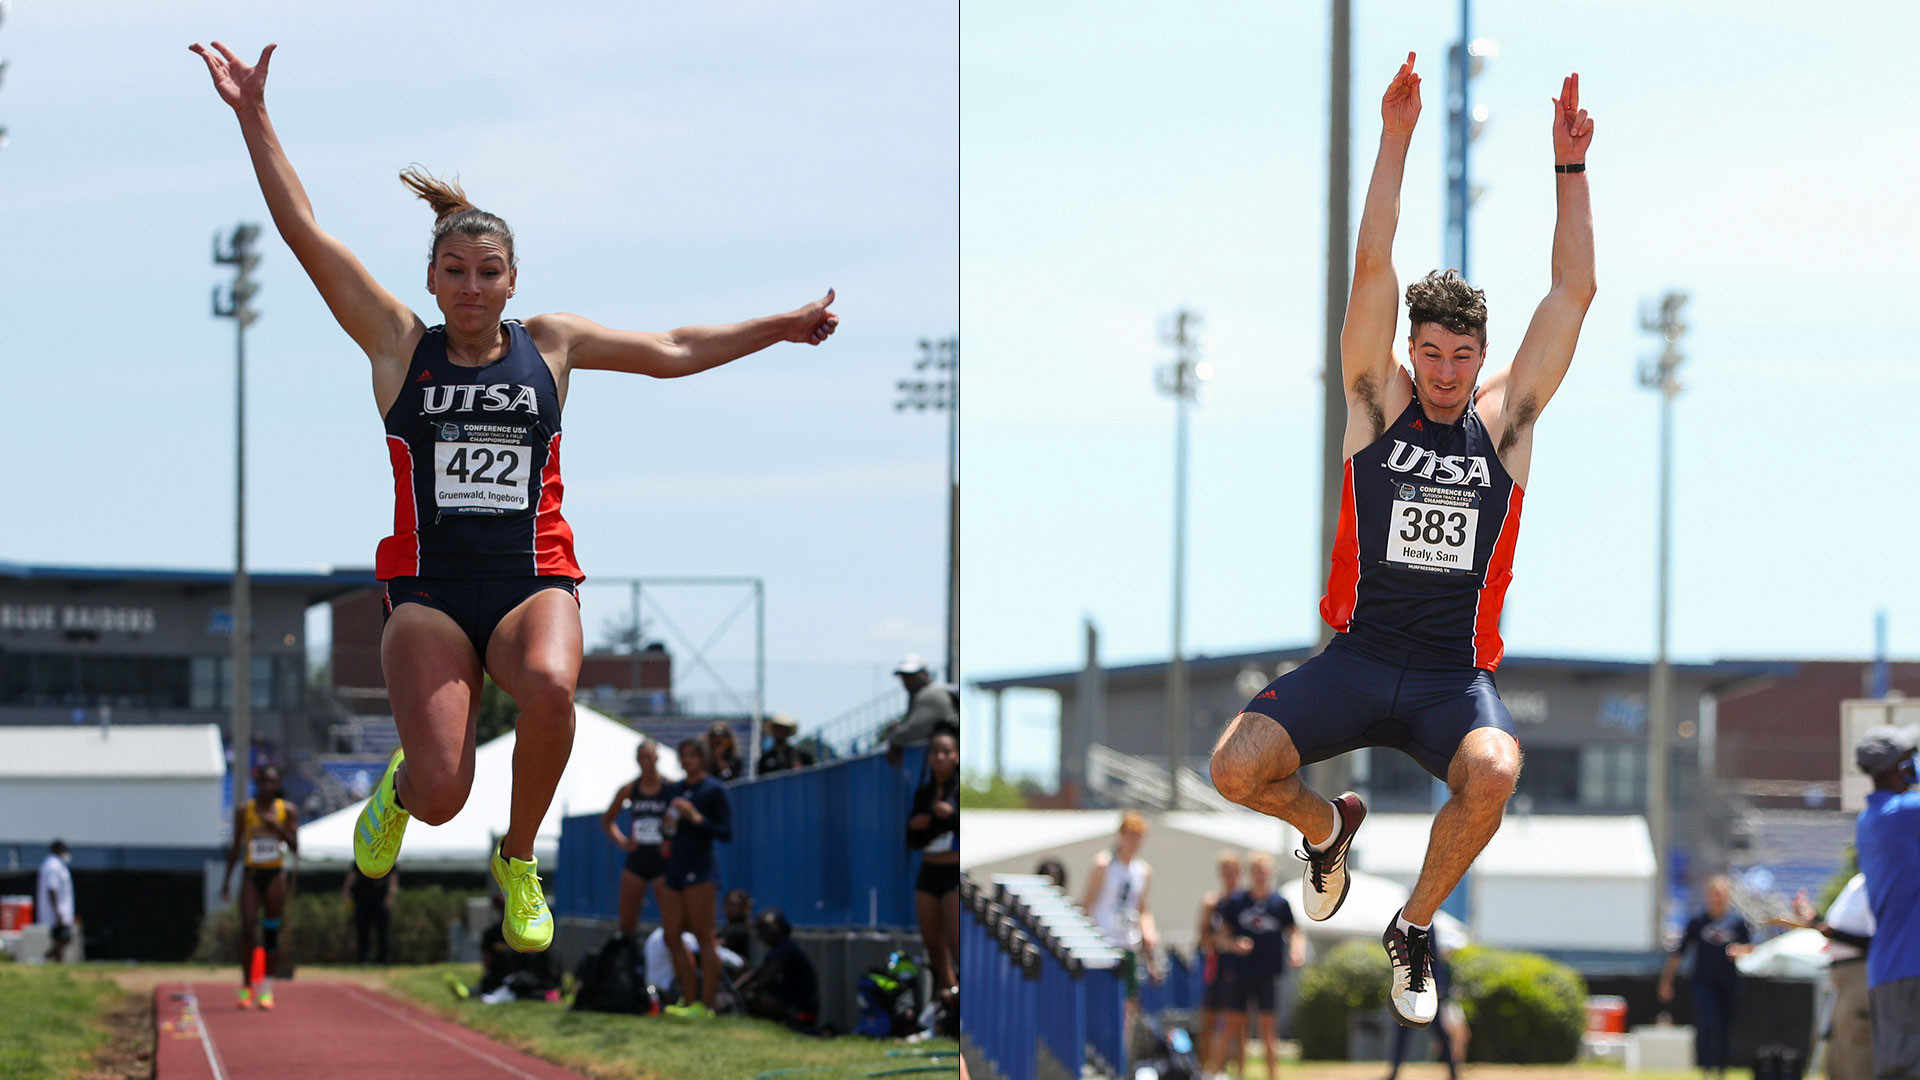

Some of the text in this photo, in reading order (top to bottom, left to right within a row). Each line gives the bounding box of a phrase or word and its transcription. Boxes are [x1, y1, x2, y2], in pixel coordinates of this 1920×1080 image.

[422, 383, 540, 416] UTSA
[463, 424, 512, 433] CONFERENCE
[469, 436, 521, 445] CHAMPIONSHIPS
[446, 447, 519, 487] 422
[1387, 439, 1492, 488] UTSA
[439, 490, 525, 505] Gruenwald, Ingeborg
[1419, 485, 1476, 498] CONFERENCE USA
[1423, 497, 1470, 508] CHAMPIONSHIPS
[1400, 507, 1467, 547] 383
[1402, 546, 1459, 563] Healy, Sam
